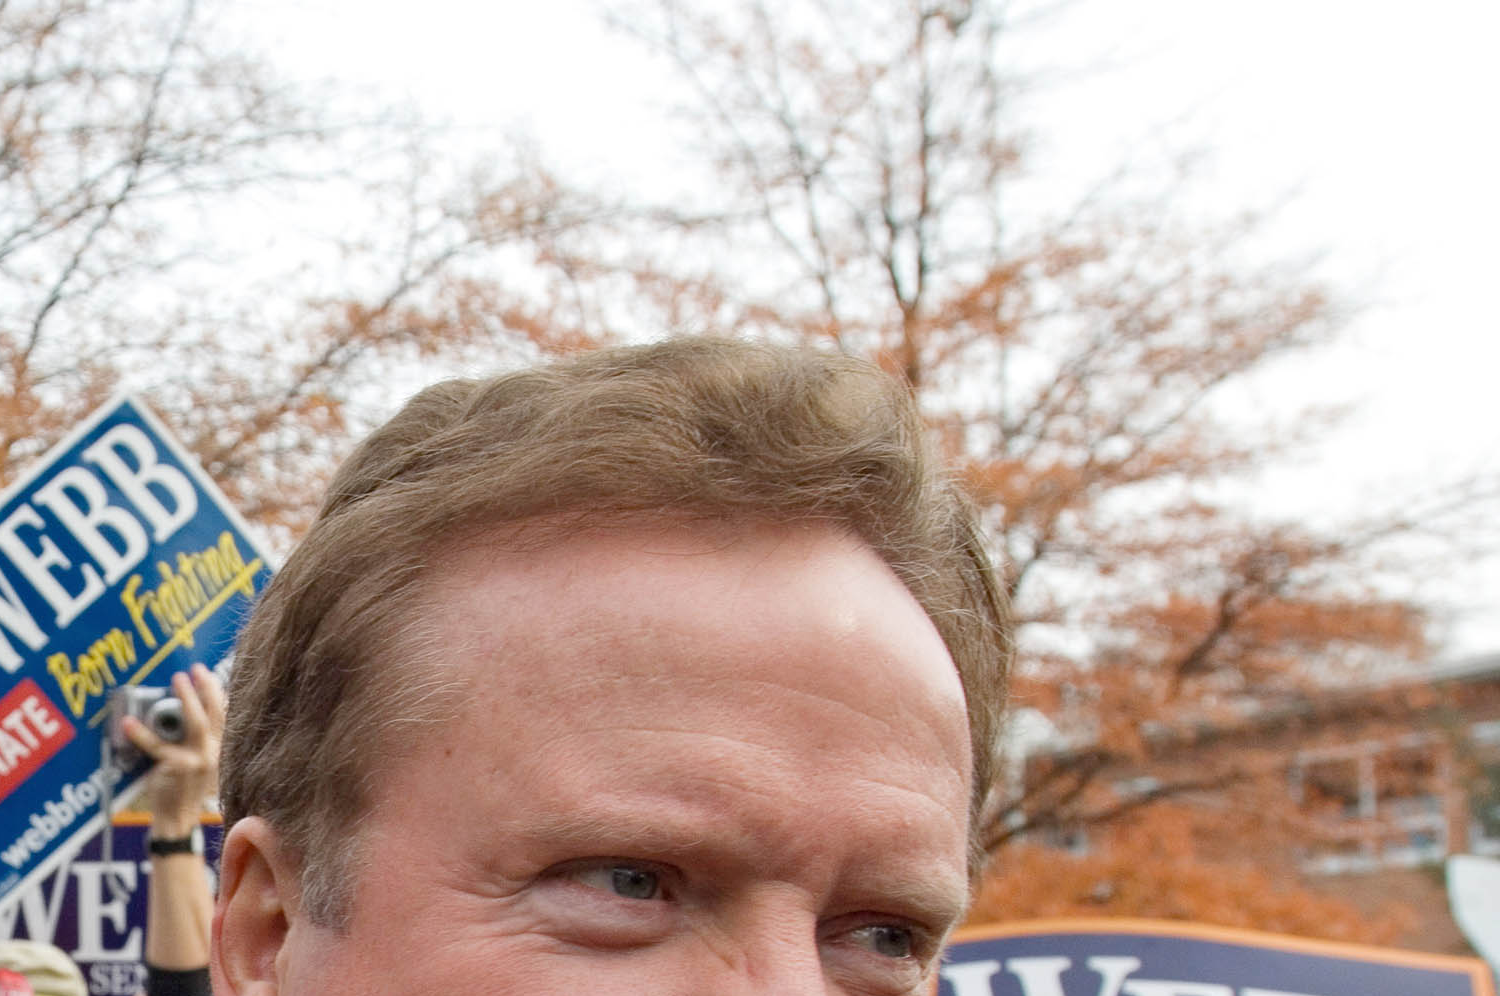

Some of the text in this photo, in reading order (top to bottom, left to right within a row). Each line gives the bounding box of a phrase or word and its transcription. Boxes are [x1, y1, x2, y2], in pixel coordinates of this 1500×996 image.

[46, 531, 256, 719] Born Fighting
[88, 961, 149, 996] SEN
